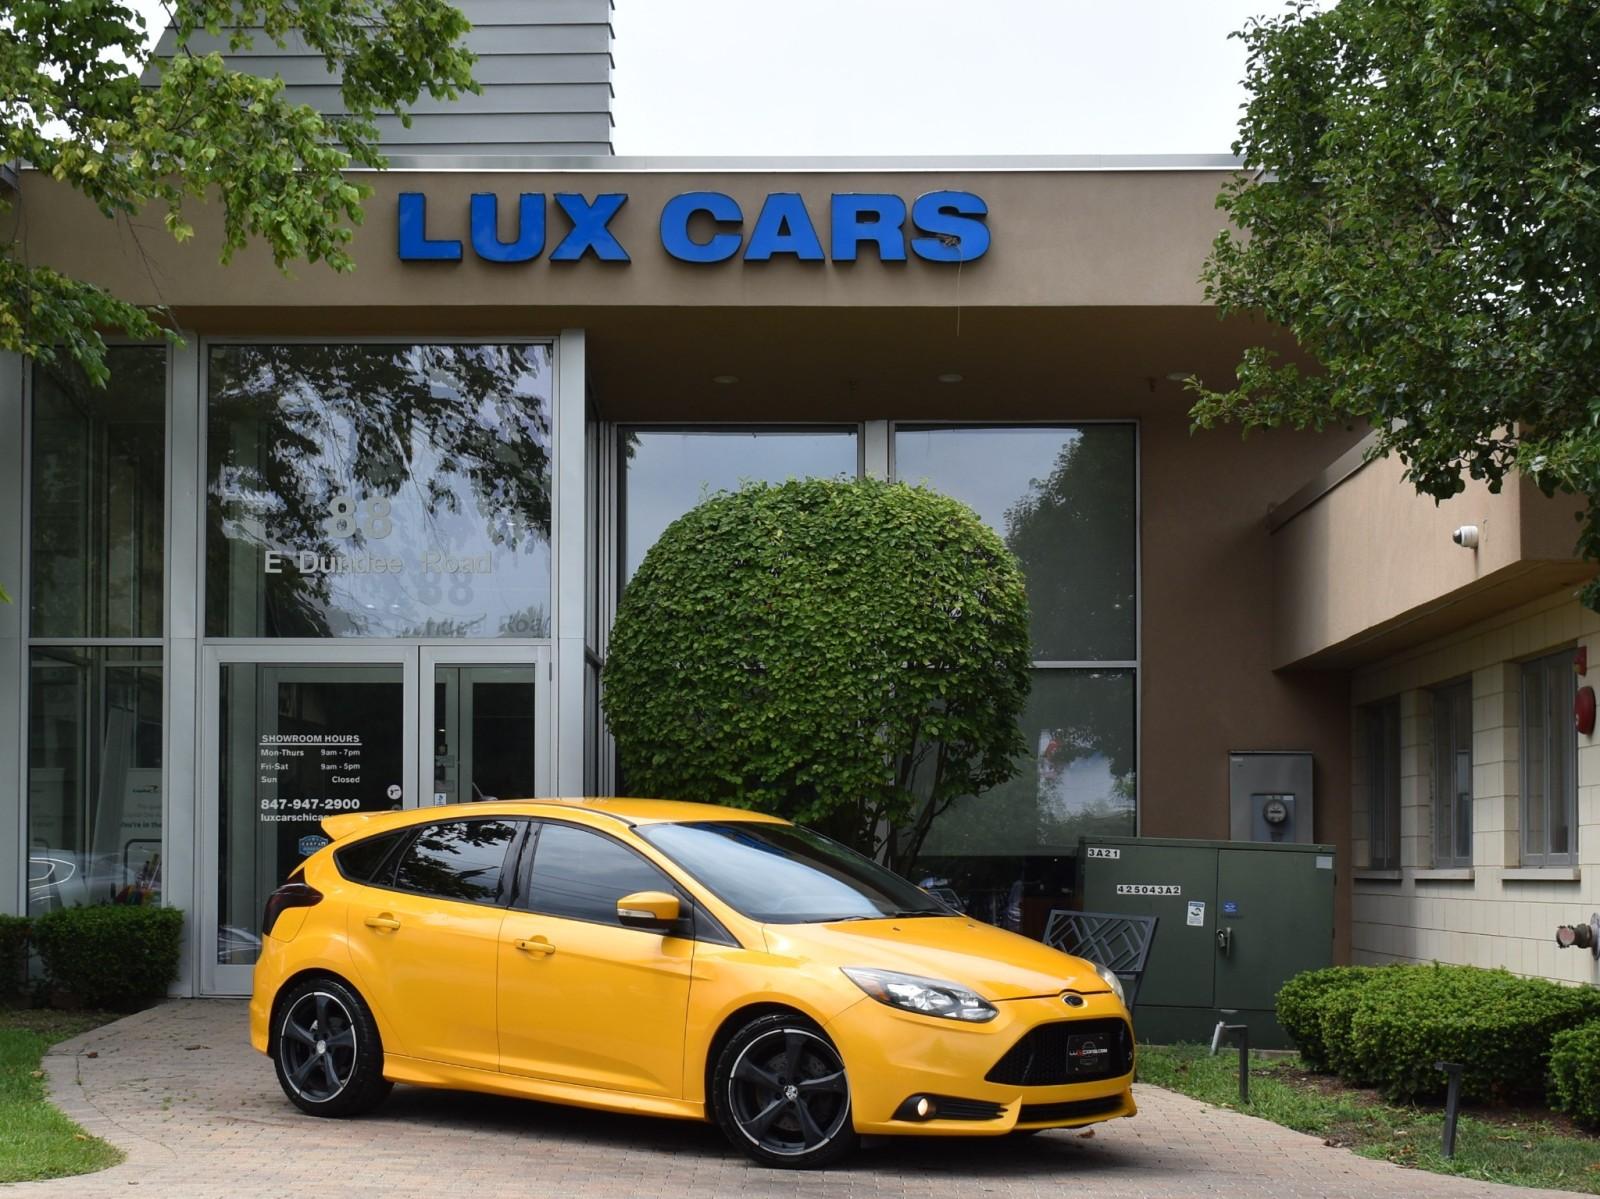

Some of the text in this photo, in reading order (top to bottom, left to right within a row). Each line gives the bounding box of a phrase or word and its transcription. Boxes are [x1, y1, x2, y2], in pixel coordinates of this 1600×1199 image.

[397, 188, 992, 264] LUX CARS
[327, 496, 393, 539] 88
[264, 550, 493, 574] E Dundee Road
[262, 734, 360, 743] SHOWROOM HOURS
[260, 748, 305, 757] Mon-Thurs
[320, 748, 337, 756] 9am
[343, 748, 361, 757] 7pm
[260, 762, 289, 770] Fri-Sat
[320, 763, 337, 771] 9am
[343, 763, 361, 771] 5pm
[331, 775, 361, 783] Closed
[260, 798, 360, 810] 847-947-2900
[1088, 848, 1118, 858] 3A21
[1117, 885, 1180, 895] 425043A2
